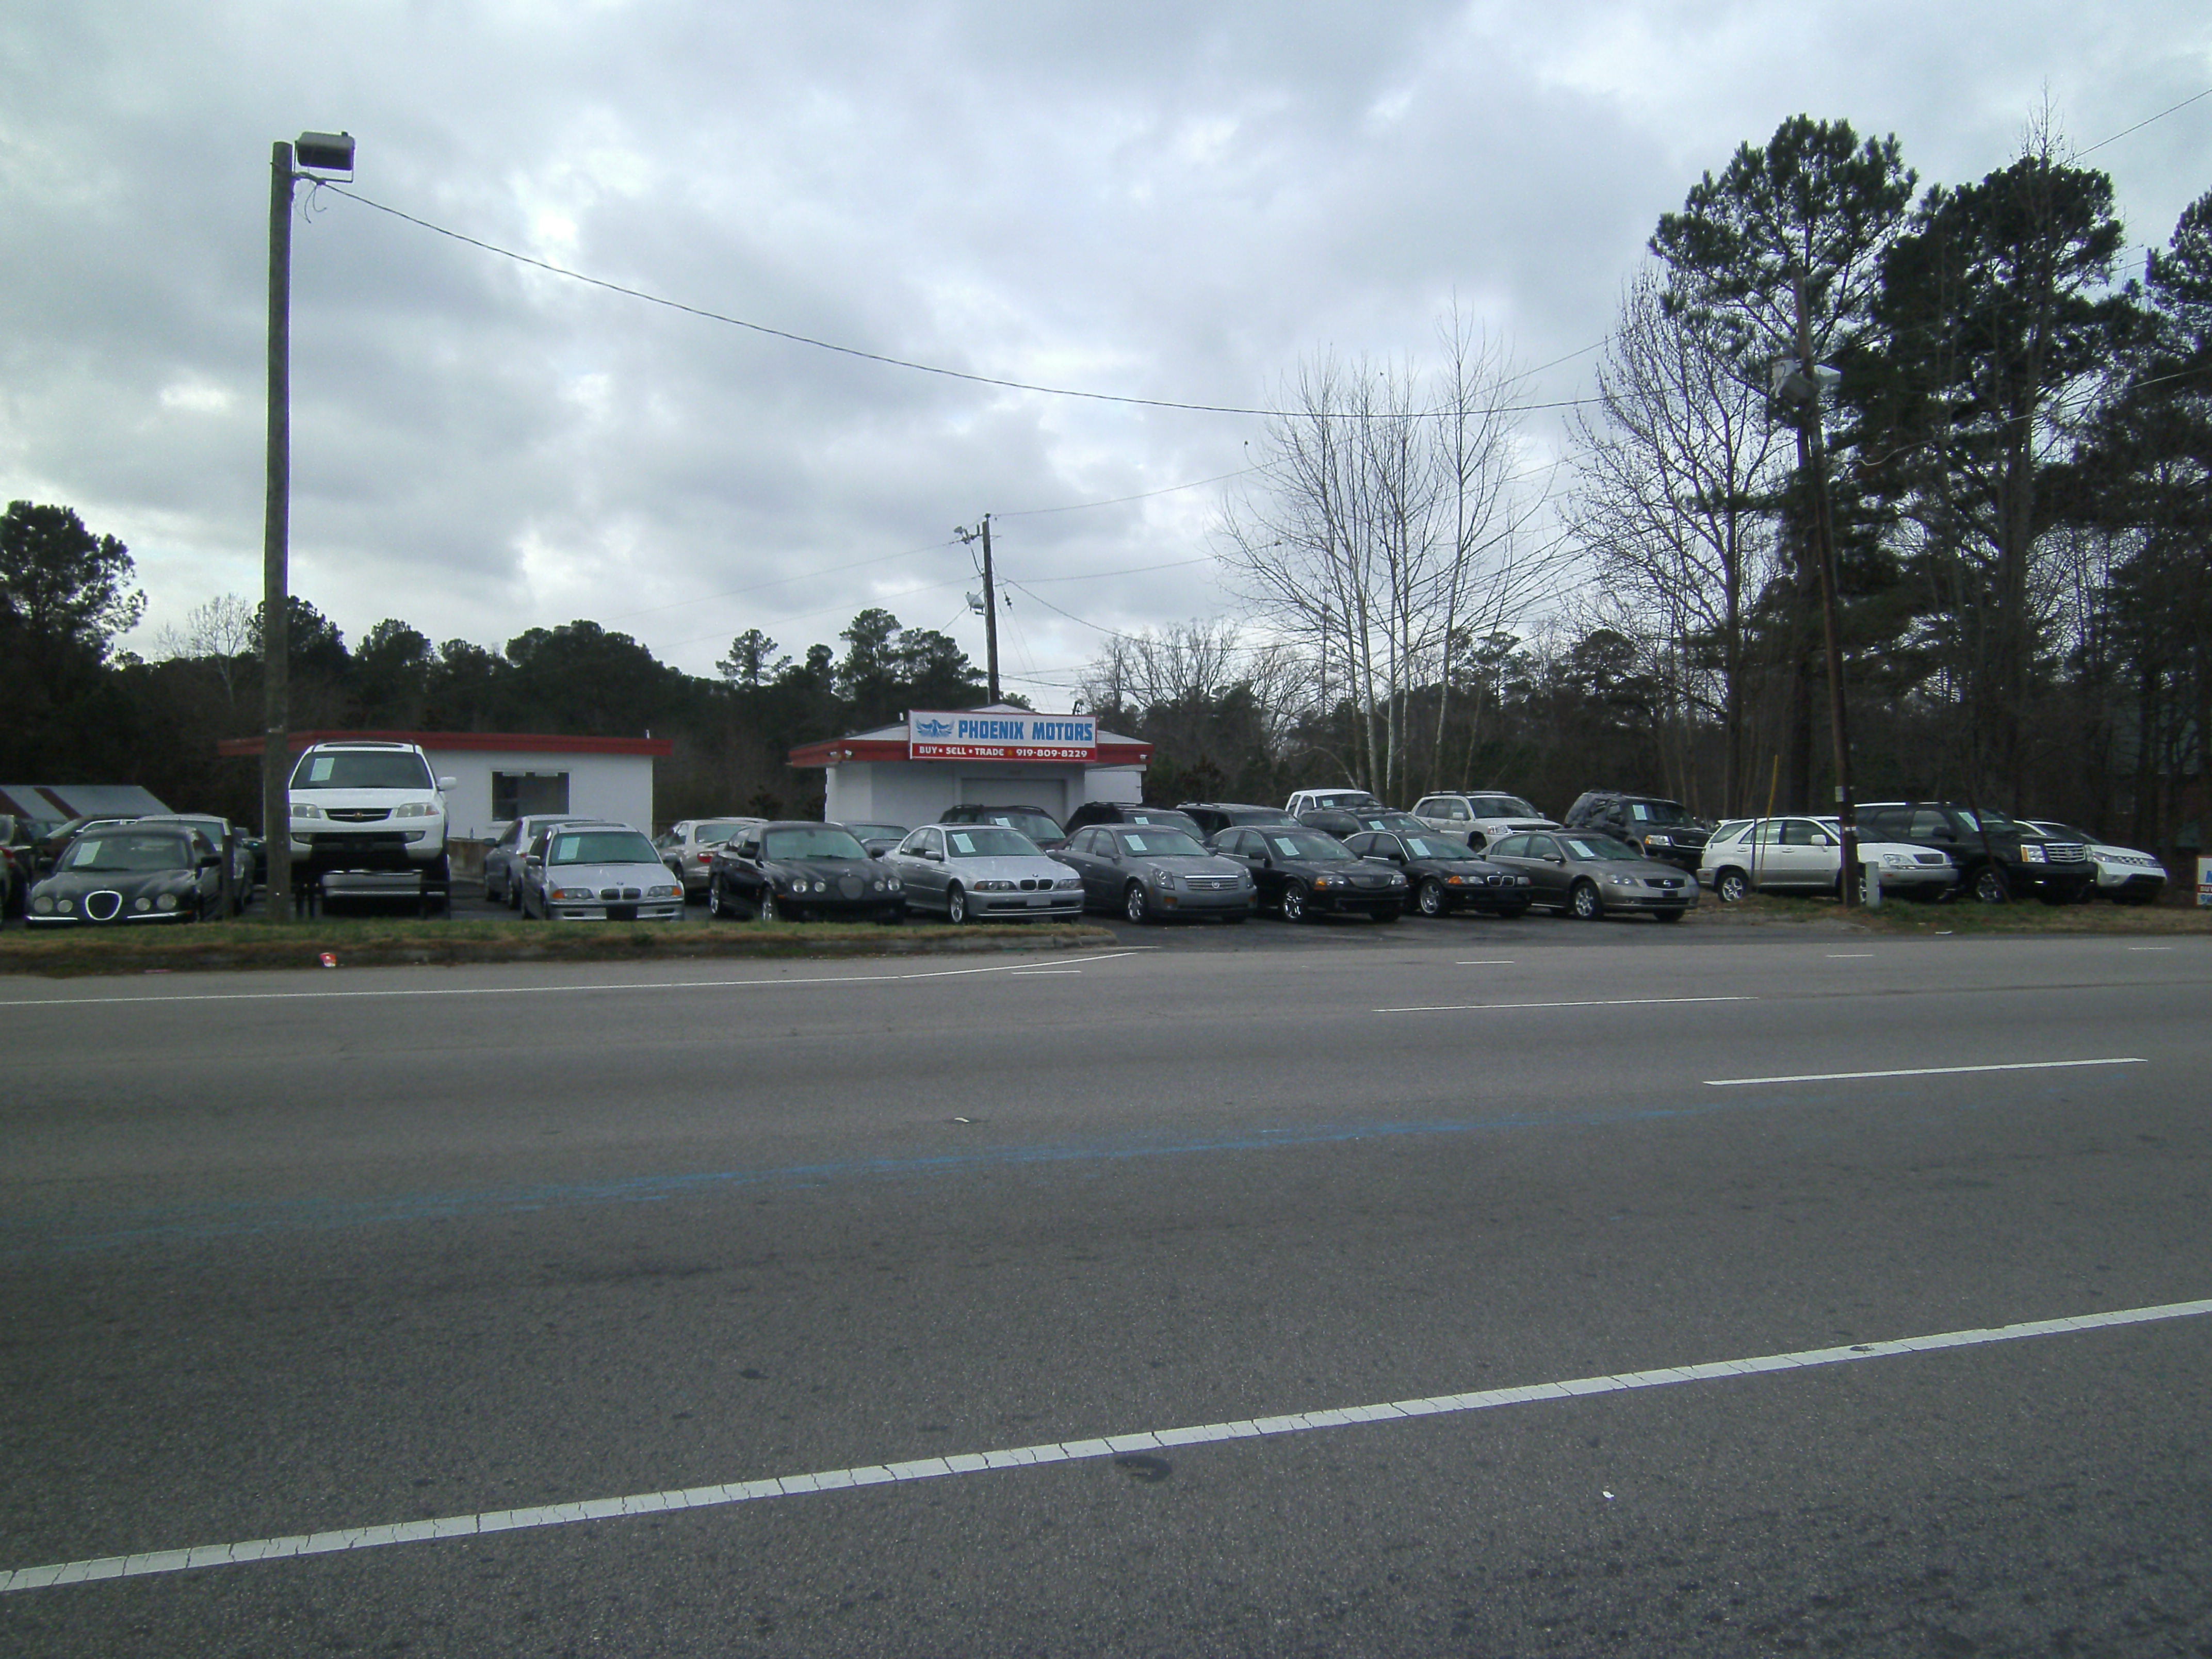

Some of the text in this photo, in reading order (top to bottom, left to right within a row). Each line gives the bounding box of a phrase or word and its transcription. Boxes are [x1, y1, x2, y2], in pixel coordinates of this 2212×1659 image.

[958, 720, 1093, 741] PHOENIX MOTORS
[974, 747, 1004, 756] TRADE
[1016, 749, 1087, 758] 919-809-8229
